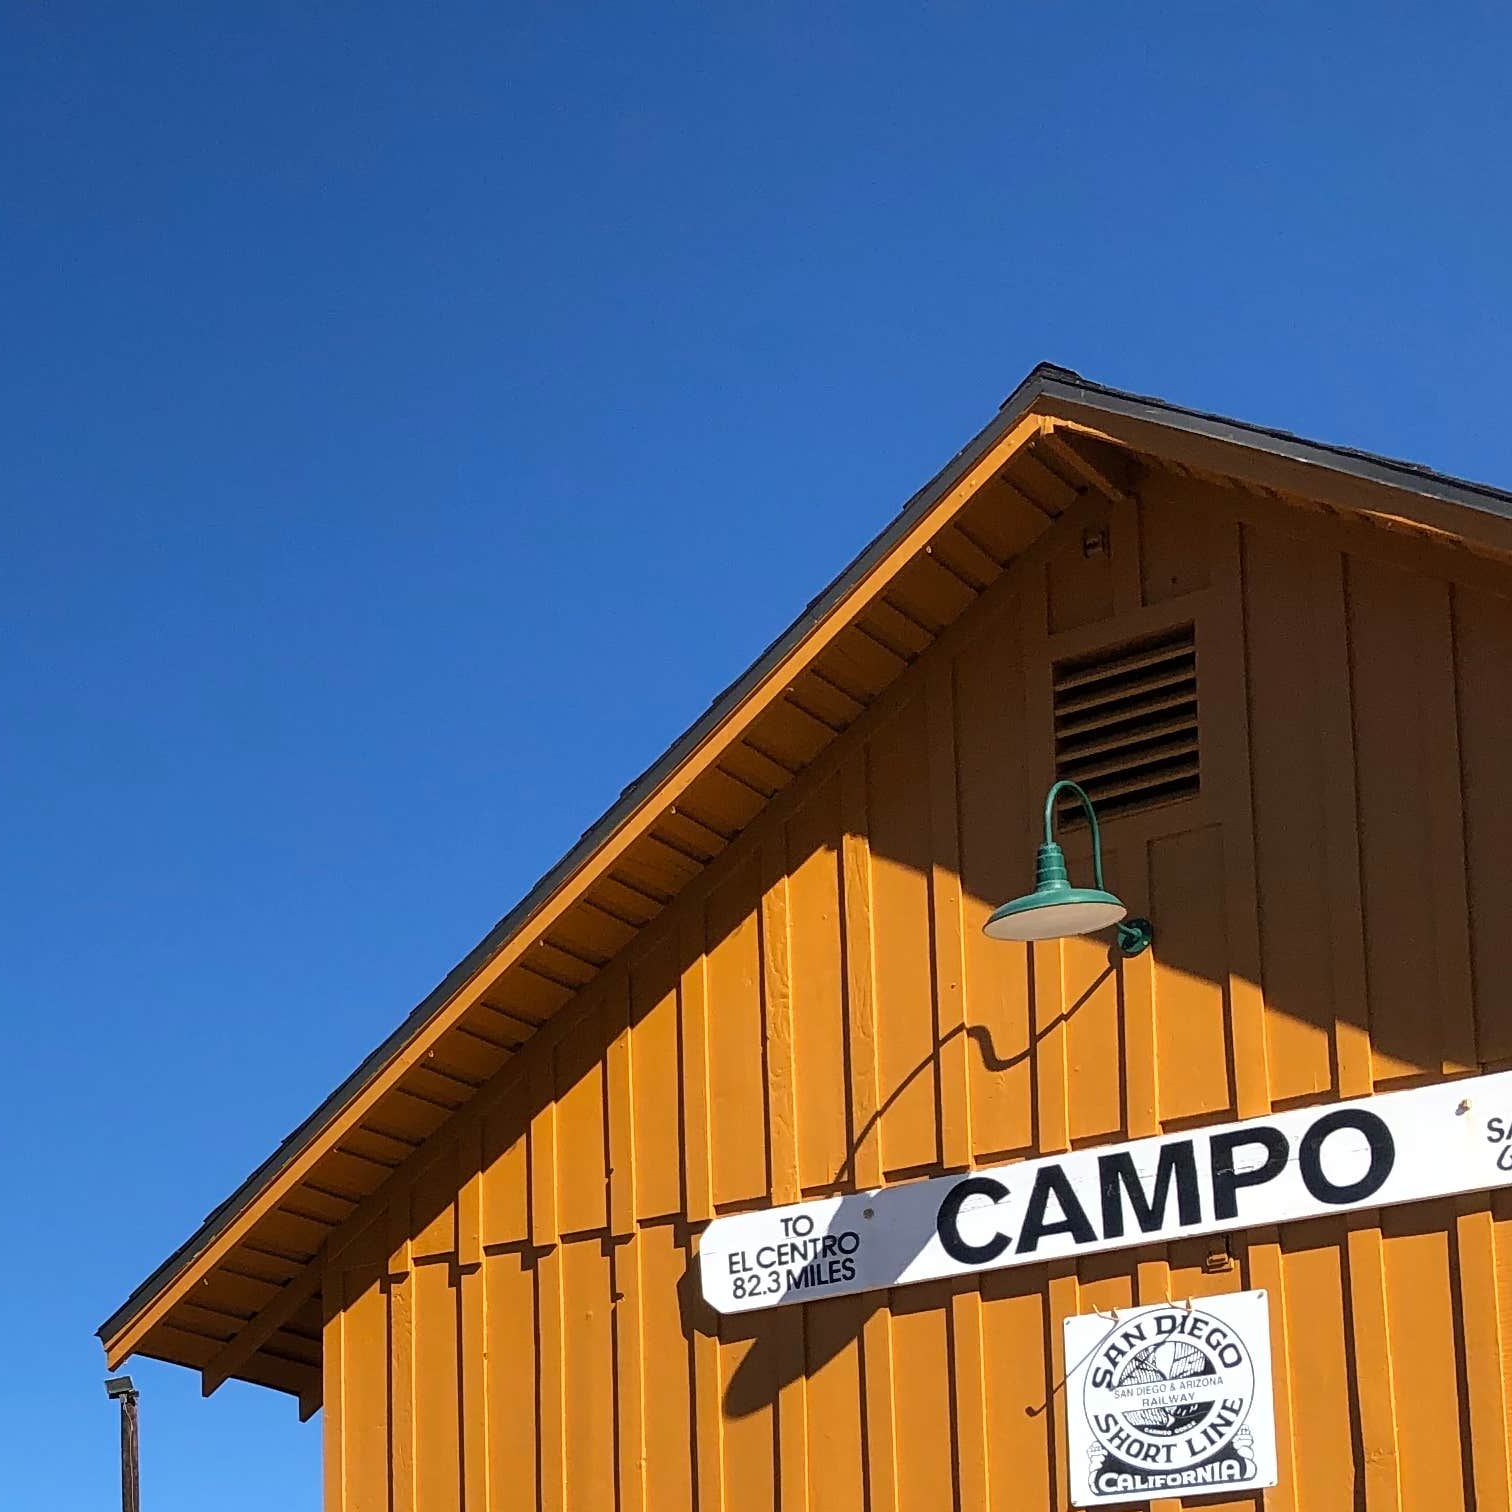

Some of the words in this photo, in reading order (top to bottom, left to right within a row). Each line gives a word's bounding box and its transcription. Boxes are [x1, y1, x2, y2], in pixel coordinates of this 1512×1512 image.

[1487, 1117, 1512, 1143] S
[937, 1108, 1396, 1265] CAMPO
[780, 1214, 814, 1237] TO
[728, 1251, 753, 1275] EL
[756, 1231, 860, 1269] CENTRO
[732, 1270, 781, 1299] 82.3
[786, 1257, 856, 1291] MILES
[1091, 1322, 1147, 1391] SAN
[1154, 1314, 1243, 1369] DIEGO
[1114, 1388, 1134, 1399] SAN
[1136, 1384, 1167, 1396] DIEGO
[1169, 1383, 1176, 1392] &
[1179, 1376, 1224, 1390] ARIZONA
[1093, 1413, 1178, 1464] SHORT
[1186, 1397, 1244, 1457] LINE
[1098, 1459, 1240, 1493] CALIFORNIA
